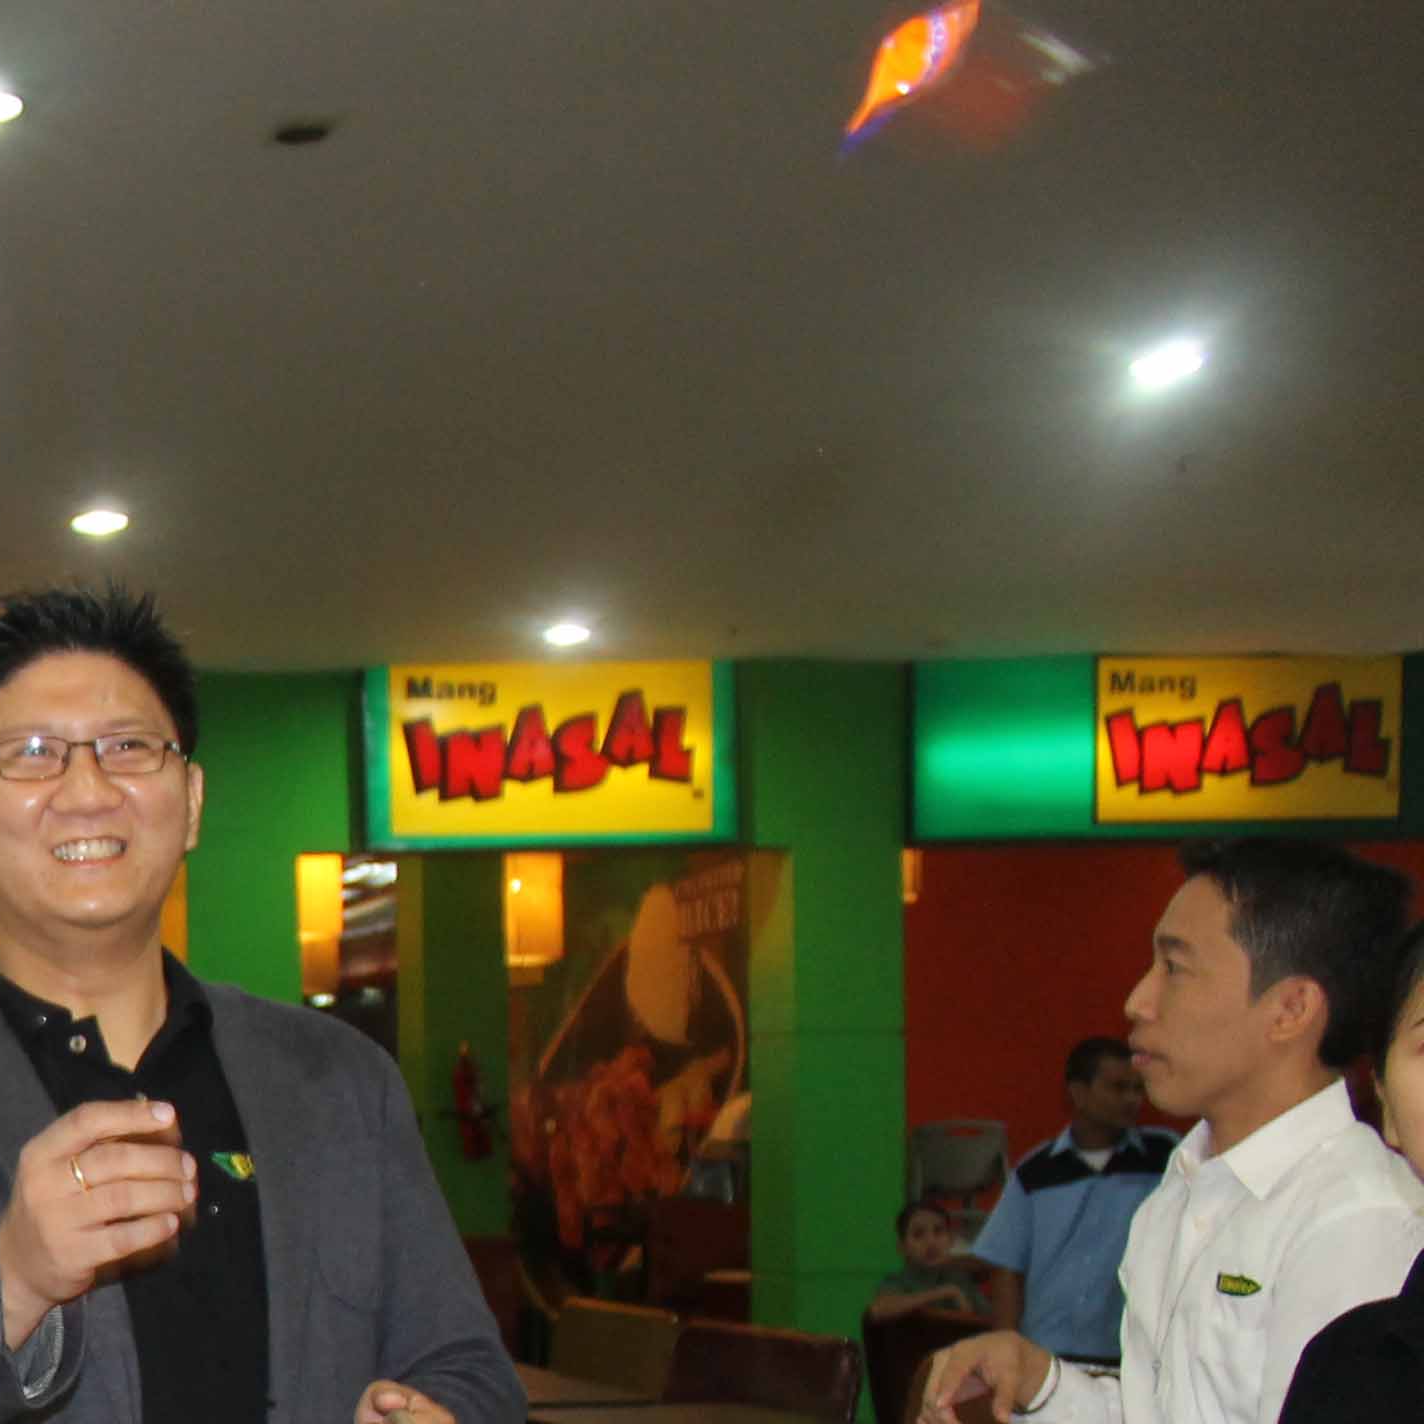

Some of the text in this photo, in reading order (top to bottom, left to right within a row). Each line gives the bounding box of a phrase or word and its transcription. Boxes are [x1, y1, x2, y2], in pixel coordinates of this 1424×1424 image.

[406, 677, 496, 705] Mang
[1109, 670, 1197, 699] Mang
[402, 688, 695, 803] INASAL
[1106, 681, 1391, 796] INASAL
